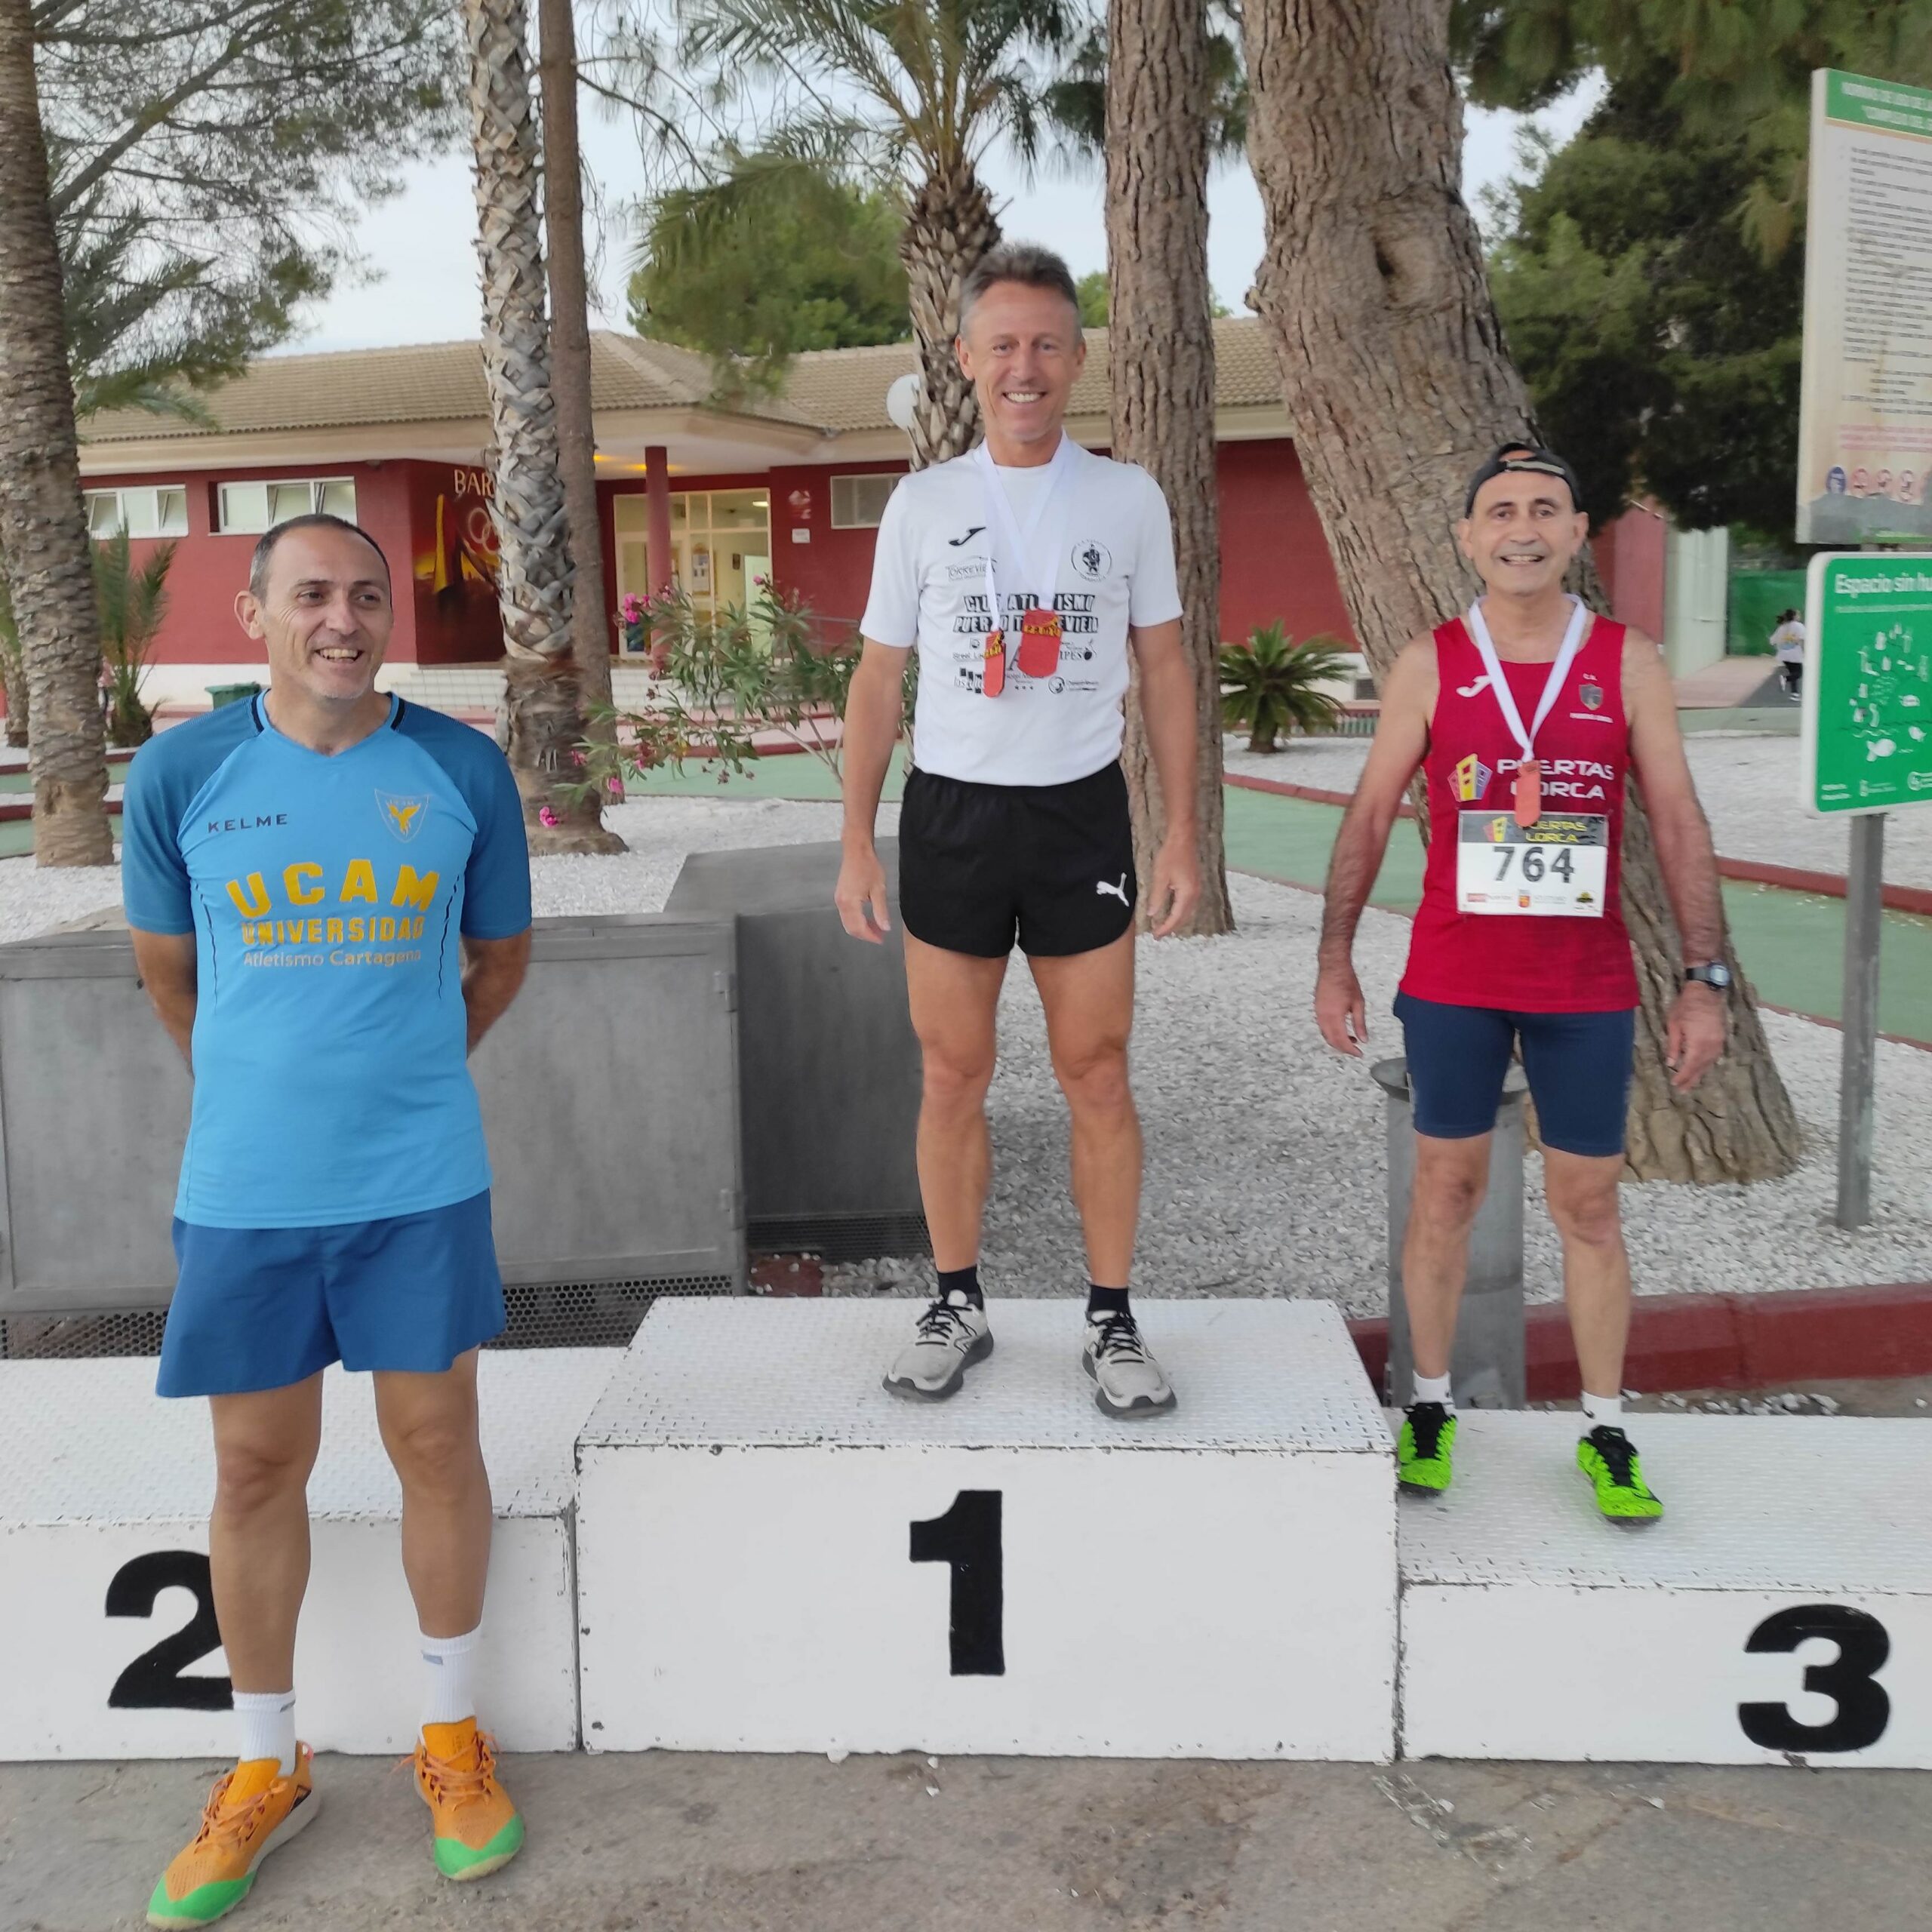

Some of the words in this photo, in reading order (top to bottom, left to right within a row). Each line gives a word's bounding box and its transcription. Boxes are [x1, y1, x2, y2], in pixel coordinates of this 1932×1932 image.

[1835, 574, 1892, 598] Espacio
[1008, 592, 1095, 612] ATLISMO
[953, 616, 1008, 633] PUERO
[1497, 758, 1615, 780] PERTAS
[208, 814, 288, 833] KELME
[1493, 846, 1575, 883] 764
[226, 859, 440, 918] UCAM
[241, 915, 426, 945] UNIVERSIDAD
[244, 950, 325, 967] Atletismo
[329, 949, 421, 968] Cartagena
[909, 1489, 1006, 1676] 1
[105, 1549, 234, 1710] 2
[1737, 1603, 1890, 1752] 3
